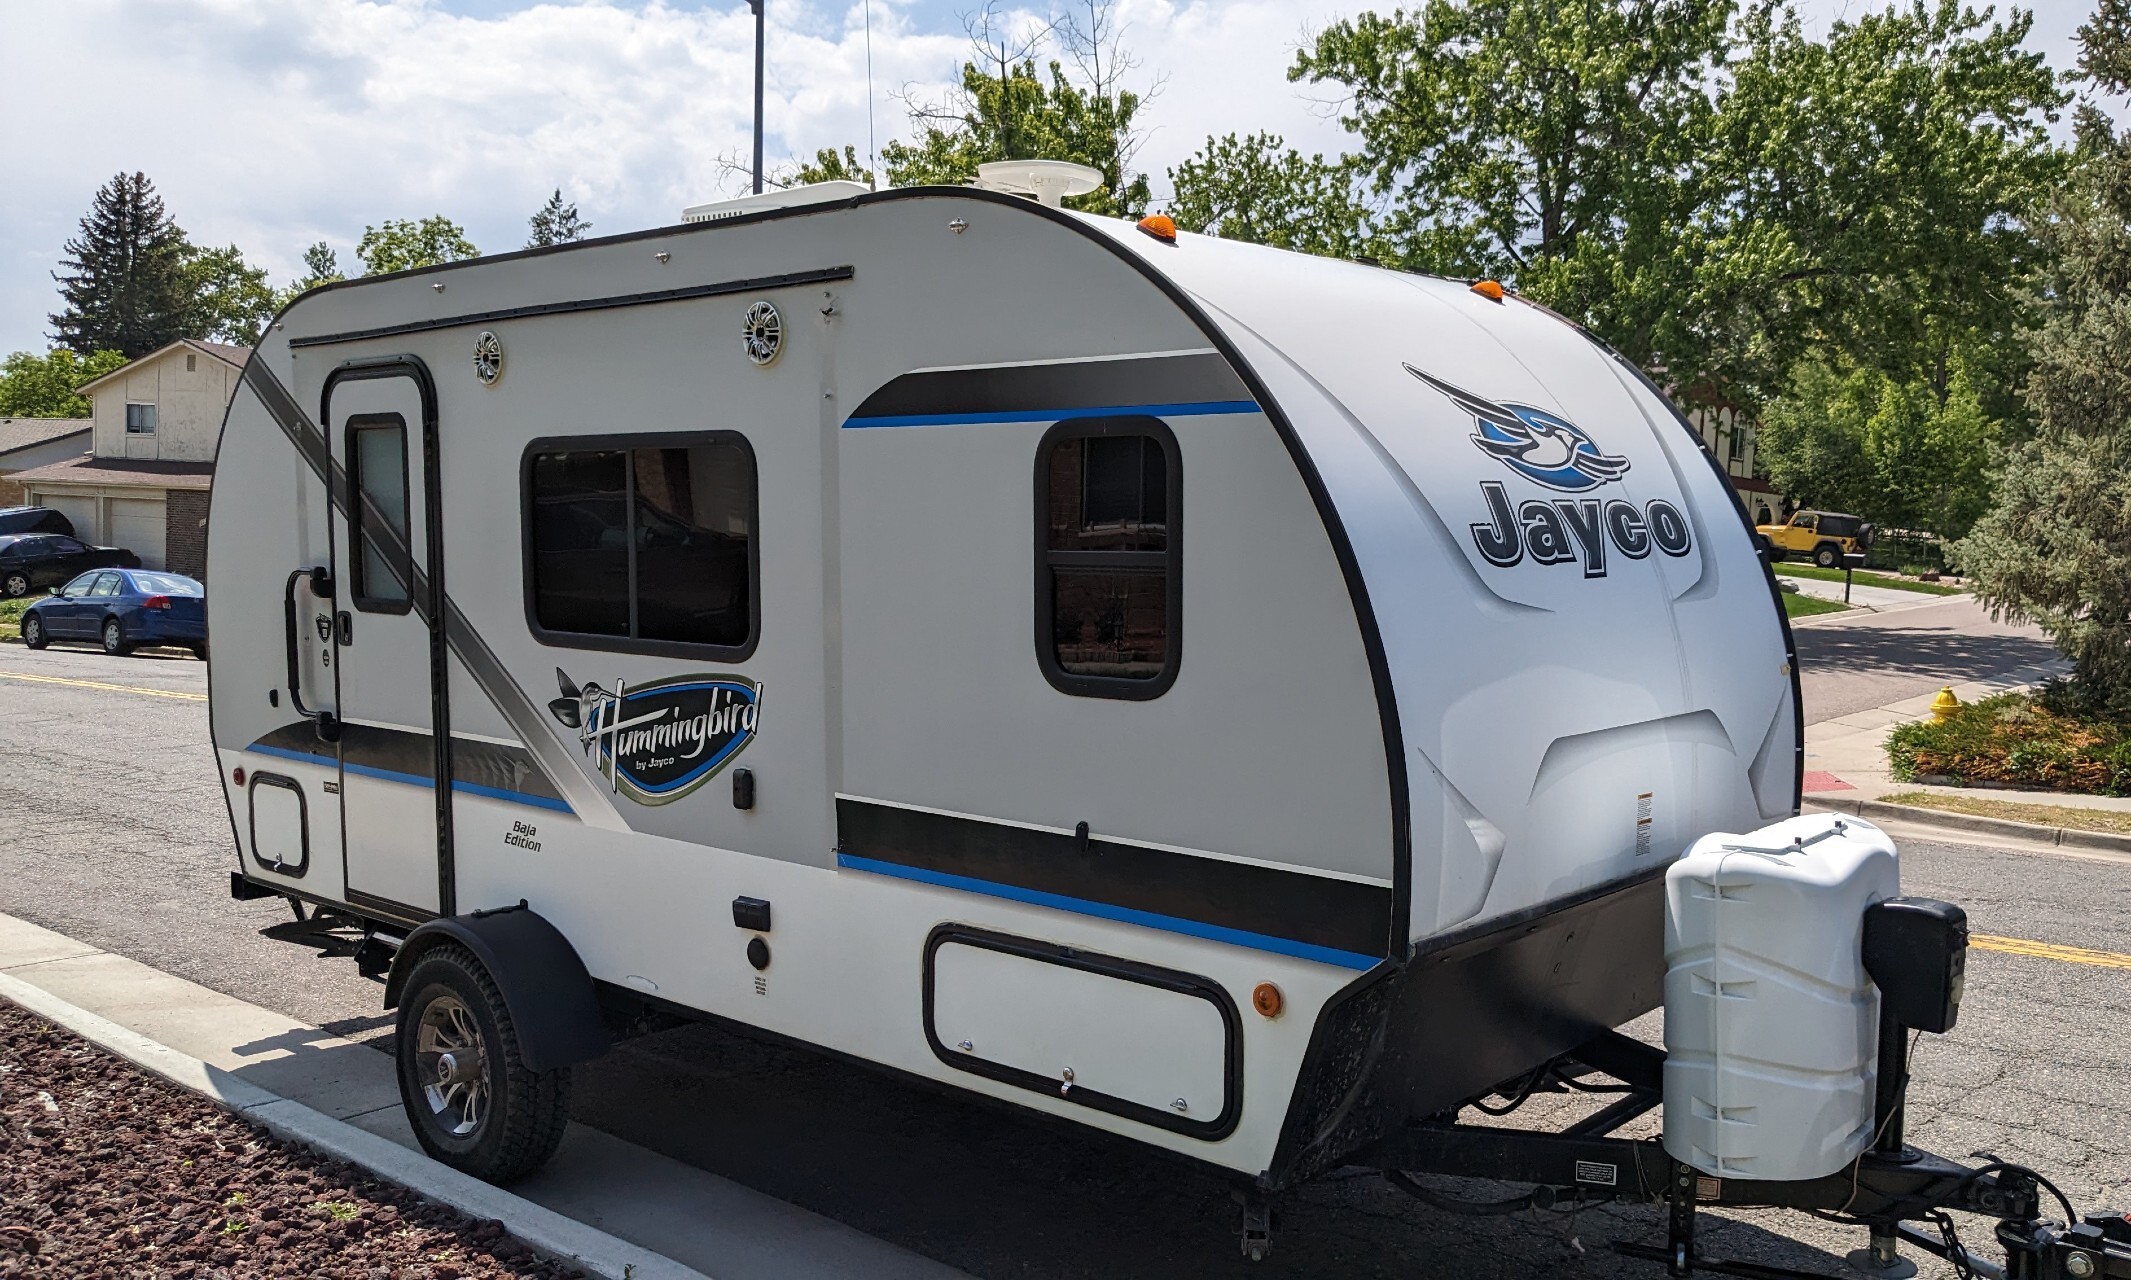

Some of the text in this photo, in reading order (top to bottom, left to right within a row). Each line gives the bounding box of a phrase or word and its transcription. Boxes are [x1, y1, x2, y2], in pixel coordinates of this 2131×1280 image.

[1469, 480, 1692, 579] Jayco
[580, 677, 764, 795] Hummingbird
[635, 757, 675, 771] by Jayco
[512, 820, 537, 837] Baja
[504, 832, 542, 853] Edition
